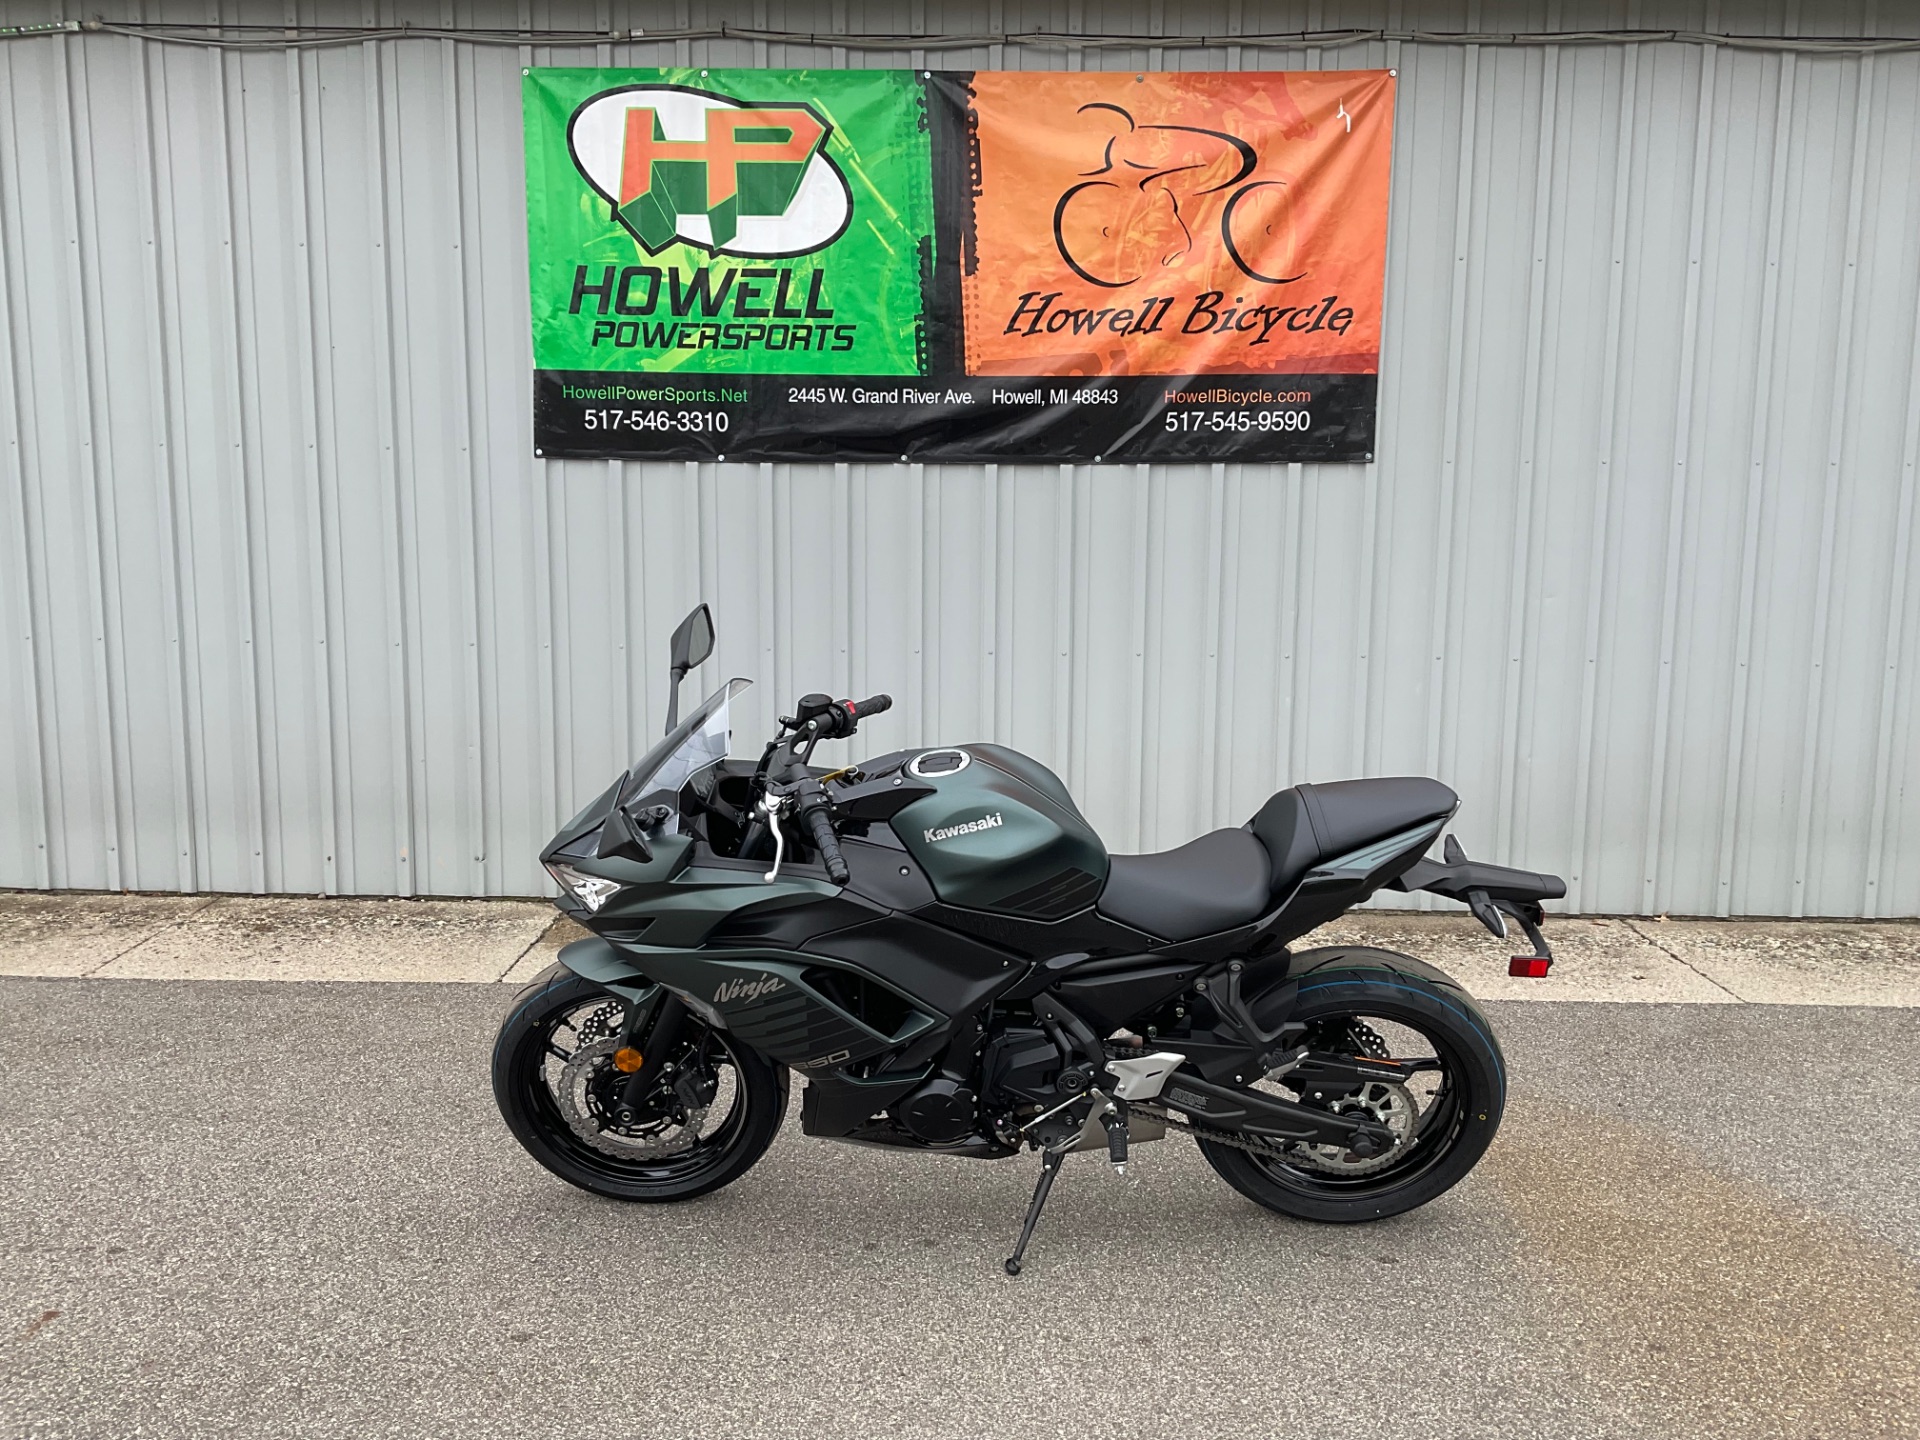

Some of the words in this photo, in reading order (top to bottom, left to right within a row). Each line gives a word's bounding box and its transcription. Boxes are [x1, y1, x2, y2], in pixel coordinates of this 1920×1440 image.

[618, 106, 825, 216] HP
[568, 265, 834, 319] HOWELL
[1003, 291, 1175, 337] Howell
[1181, 290, 1354, 346] Bicycle
[591, 321, 857, 351] POWERSPORTS
[562, 385, 748, 404] HowellPowerSports.Net
[788, 387, 826, 403] 2445
[828, 388, 848, 403] W.
[852, 388, 898, 404] Grand
[902, 388, 941, 404] River
[944, 389, 975, 404] Ave.
[992, 389, 1045, 406] Howell,
[1050, 389, 1068, 404] MI
[1072, 389, 1118, 404] 48843
[1164, 389, 1311, 406] HowellBicycle.com
[584, 409, 729, 432] 517-546-3310
[1165, 411, 1311, 432] 517-545-9590
[923, 812, 1003, 843] Kawasaki
[713, 972, 786, 1005] Ninja
